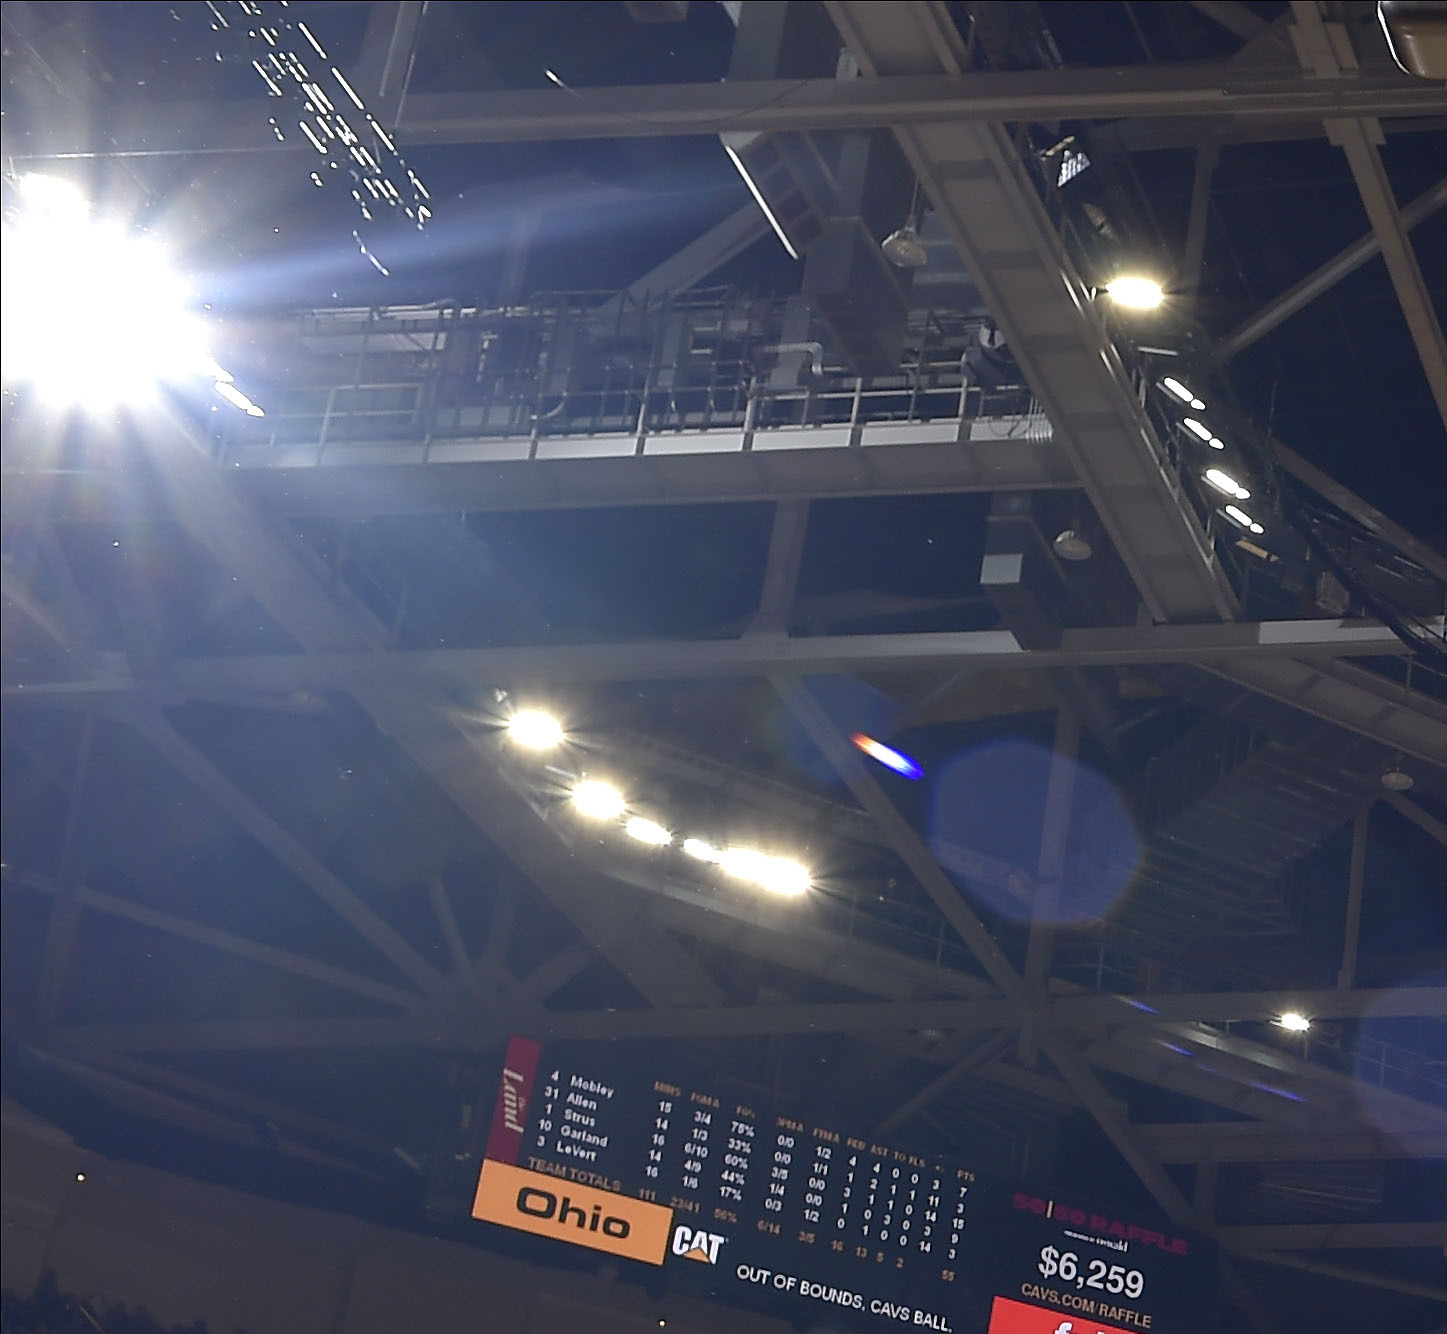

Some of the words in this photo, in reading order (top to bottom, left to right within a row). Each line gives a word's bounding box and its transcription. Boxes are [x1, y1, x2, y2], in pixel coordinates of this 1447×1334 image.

[544, 1086, 558, 1099] 31
[567, 1092, 597, 1111] Allen
[571, 1075, 614, 1099] Mobley
[539, 1119, 552, 1131] 10
[560, 1125, 608, 1148] Garland
[564, 1109, 596, 1127] Strus
[556, 1140, 597, 1161] LeVert
[528, 1157, 567, 1178] TEAM
[570, 1168, 622, 1192] TOTALS
[516, 1187, 630, 1239] Ohio
[673, 1225, 726, 1264] CAT
[1038, 1245, 1144, 1299] $6,259
[736, 1264, 771, 1288] OUT
[775, 1273, 797, 1292] OF
[800, 1280, 866, 1312] BOUNDS,
[870, 1297, 910, 1320] CAVS
[914, 1306, 953, 1333] BALL.
[1021, 1282, 1152, 1328] CAVS.COM/RAFFLE
